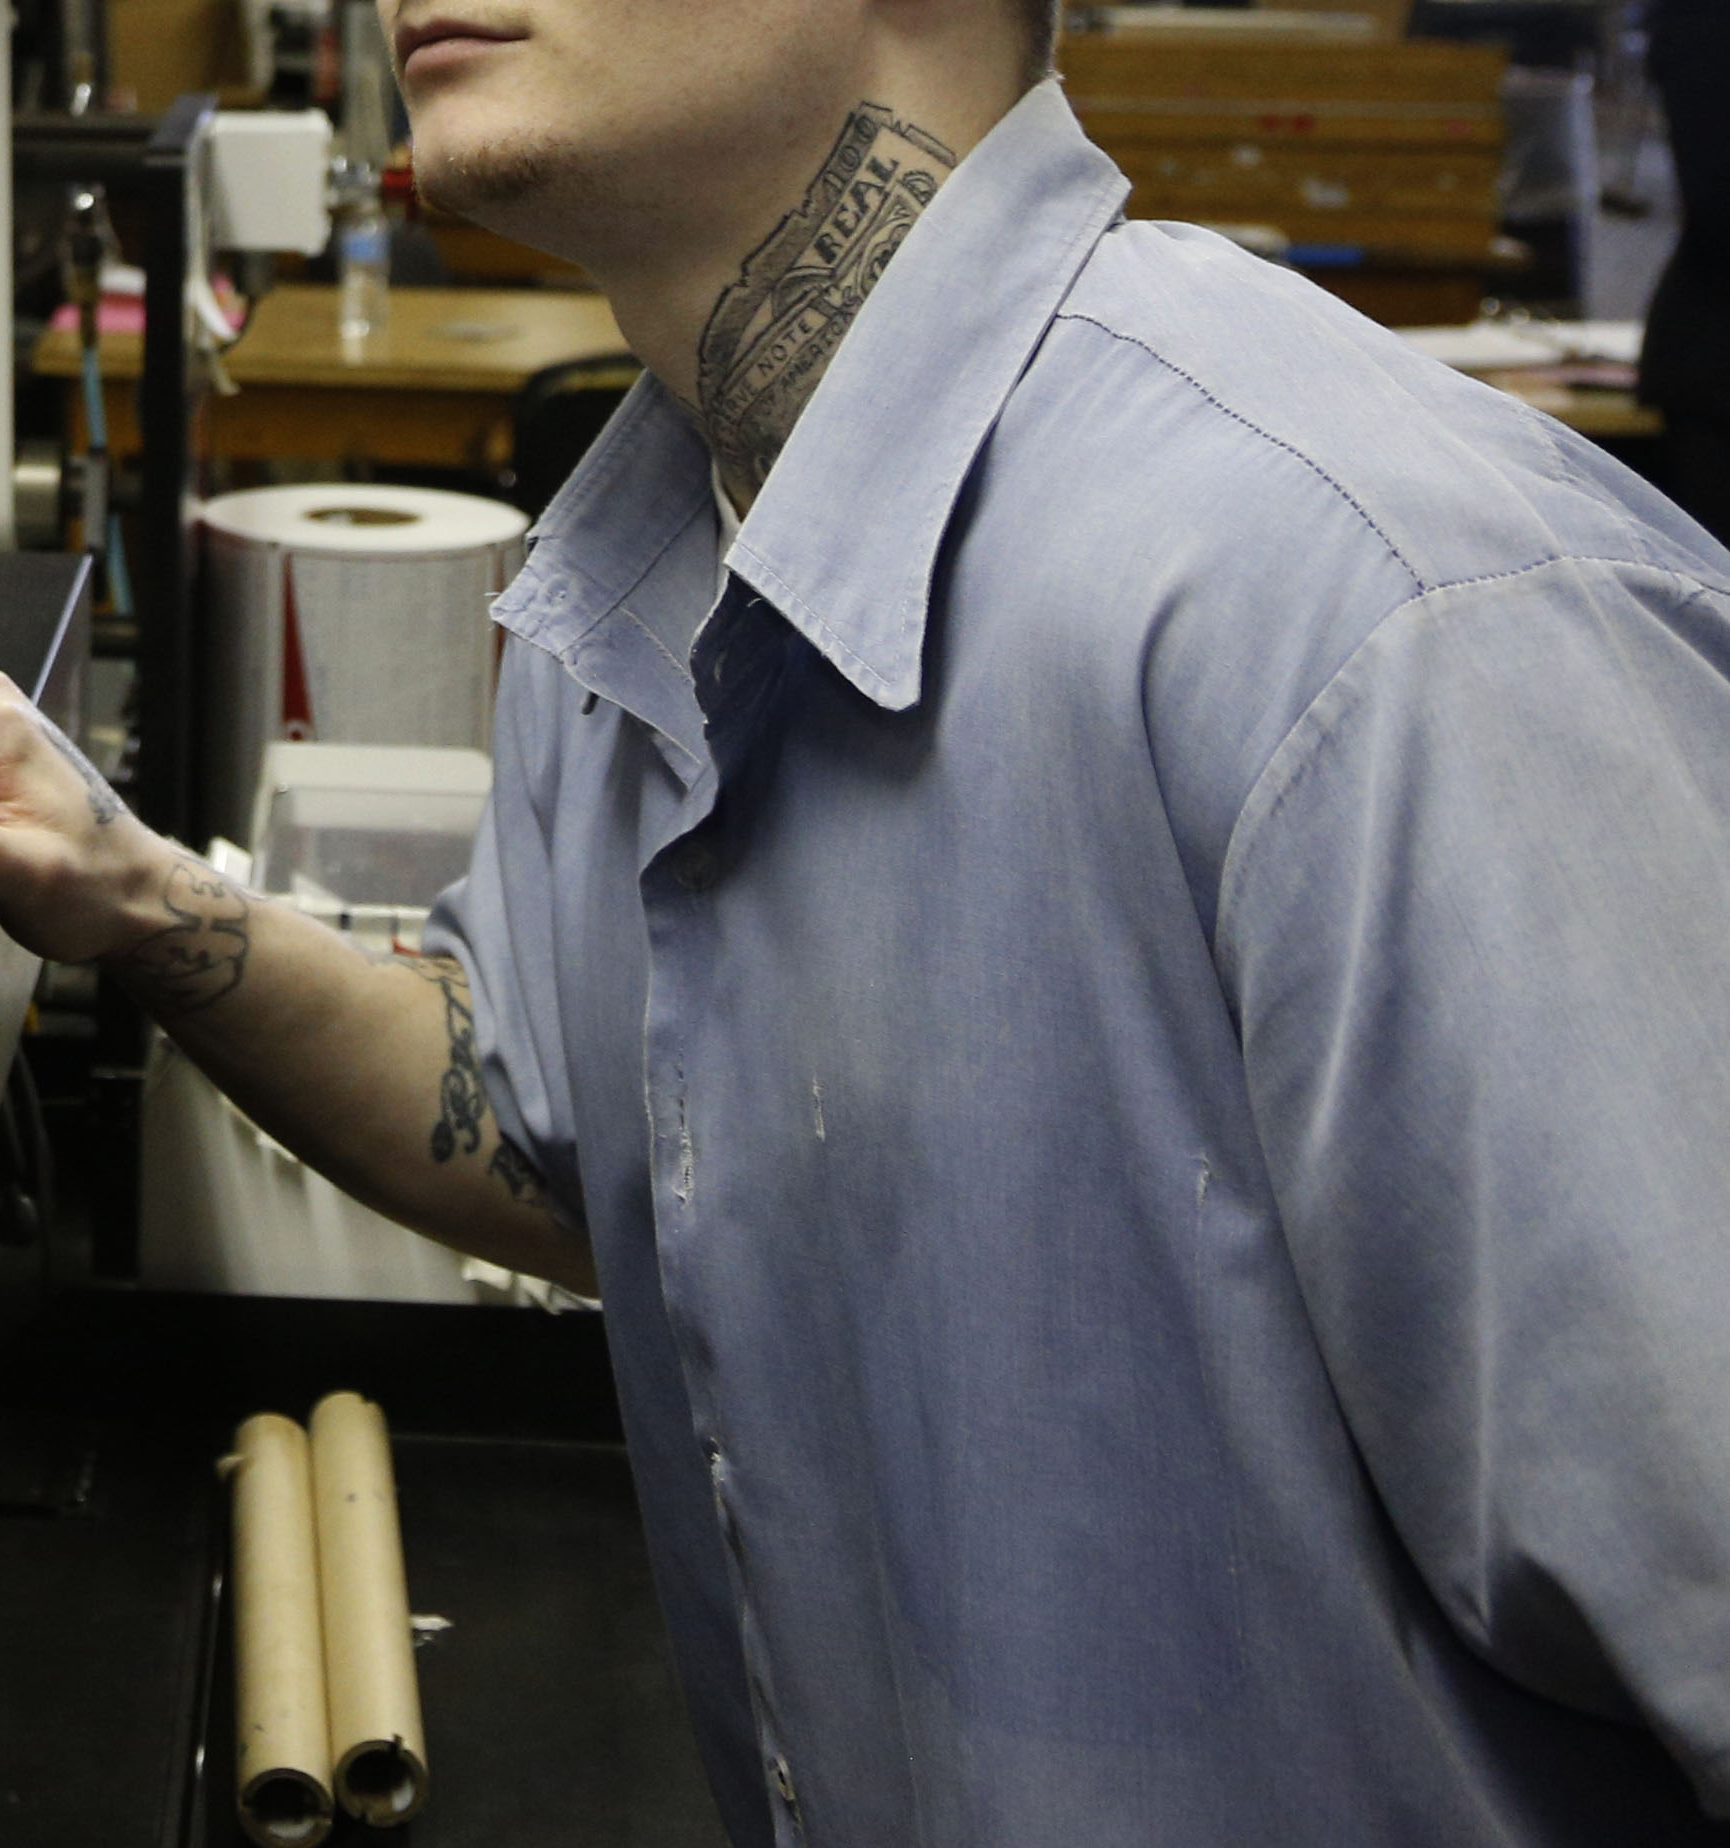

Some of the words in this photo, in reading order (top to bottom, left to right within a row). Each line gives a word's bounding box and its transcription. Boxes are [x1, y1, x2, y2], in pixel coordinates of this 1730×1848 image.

[821, 114, 881, 198] 100
[813, 157, 900, 264] REAL
[757, 320, 814, 377] NOTE
